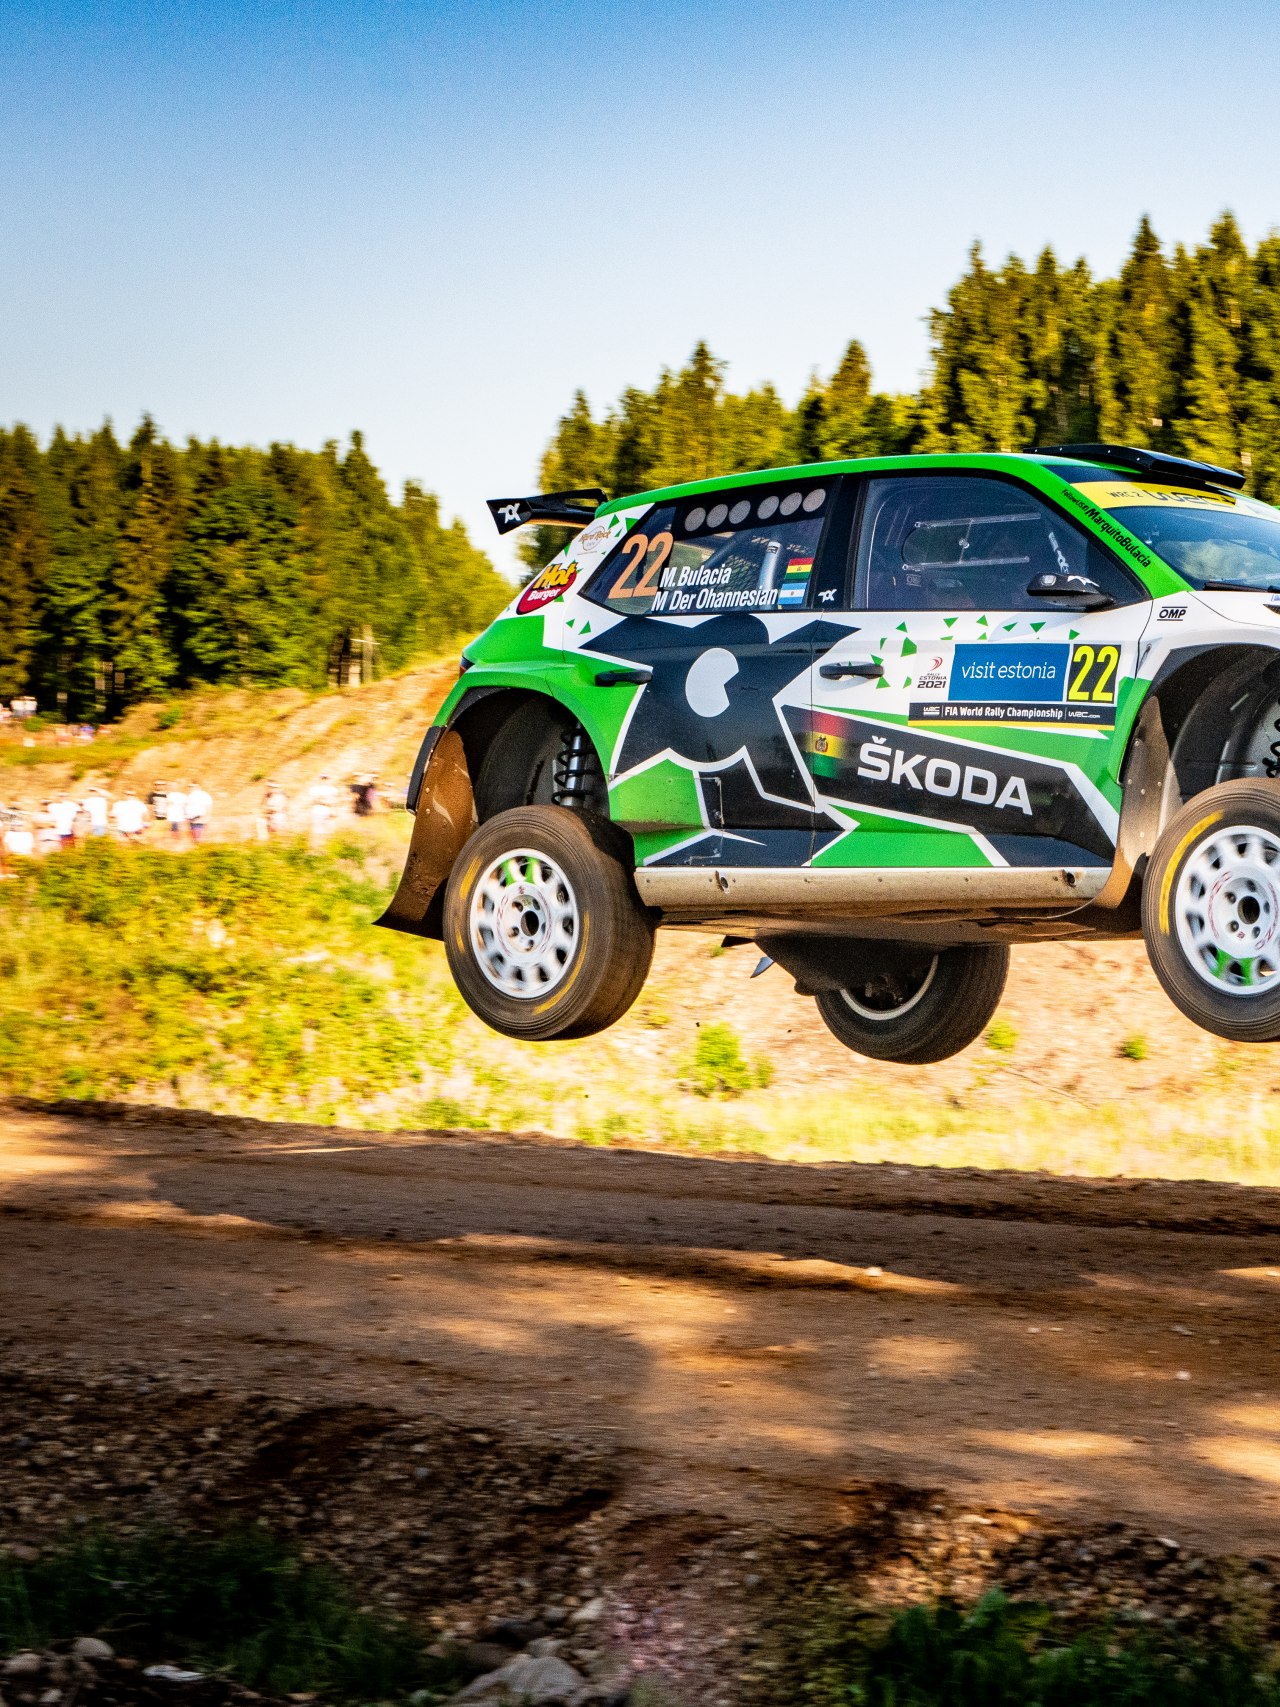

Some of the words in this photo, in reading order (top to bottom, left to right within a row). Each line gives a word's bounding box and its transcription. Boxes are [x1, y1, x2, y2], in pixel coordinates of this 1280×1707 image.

[532, 562, 578, 590] Hot
[607, 532, 674, 599] 22
[527, 588, 561, 601] Burger
[669, 590, 697, 611] Der
[695, 584, 779, 609] Ohannesian
[1158, 608, 1188, 619] OMP
[961, 662, 996, 679] visit
[997, 662, 1056, 679] estonia
[1068, 645, 1119, 702] 22
[917, 680, 947, 689] 2021
[944, 706, 958, 717] FIA
[959, 706, 982, 717] World
[985, 707, 1004, 719] Rally
[1006, 707, 1063, 720] Championship
[857, 735, 1033, 816] ŠKODA
